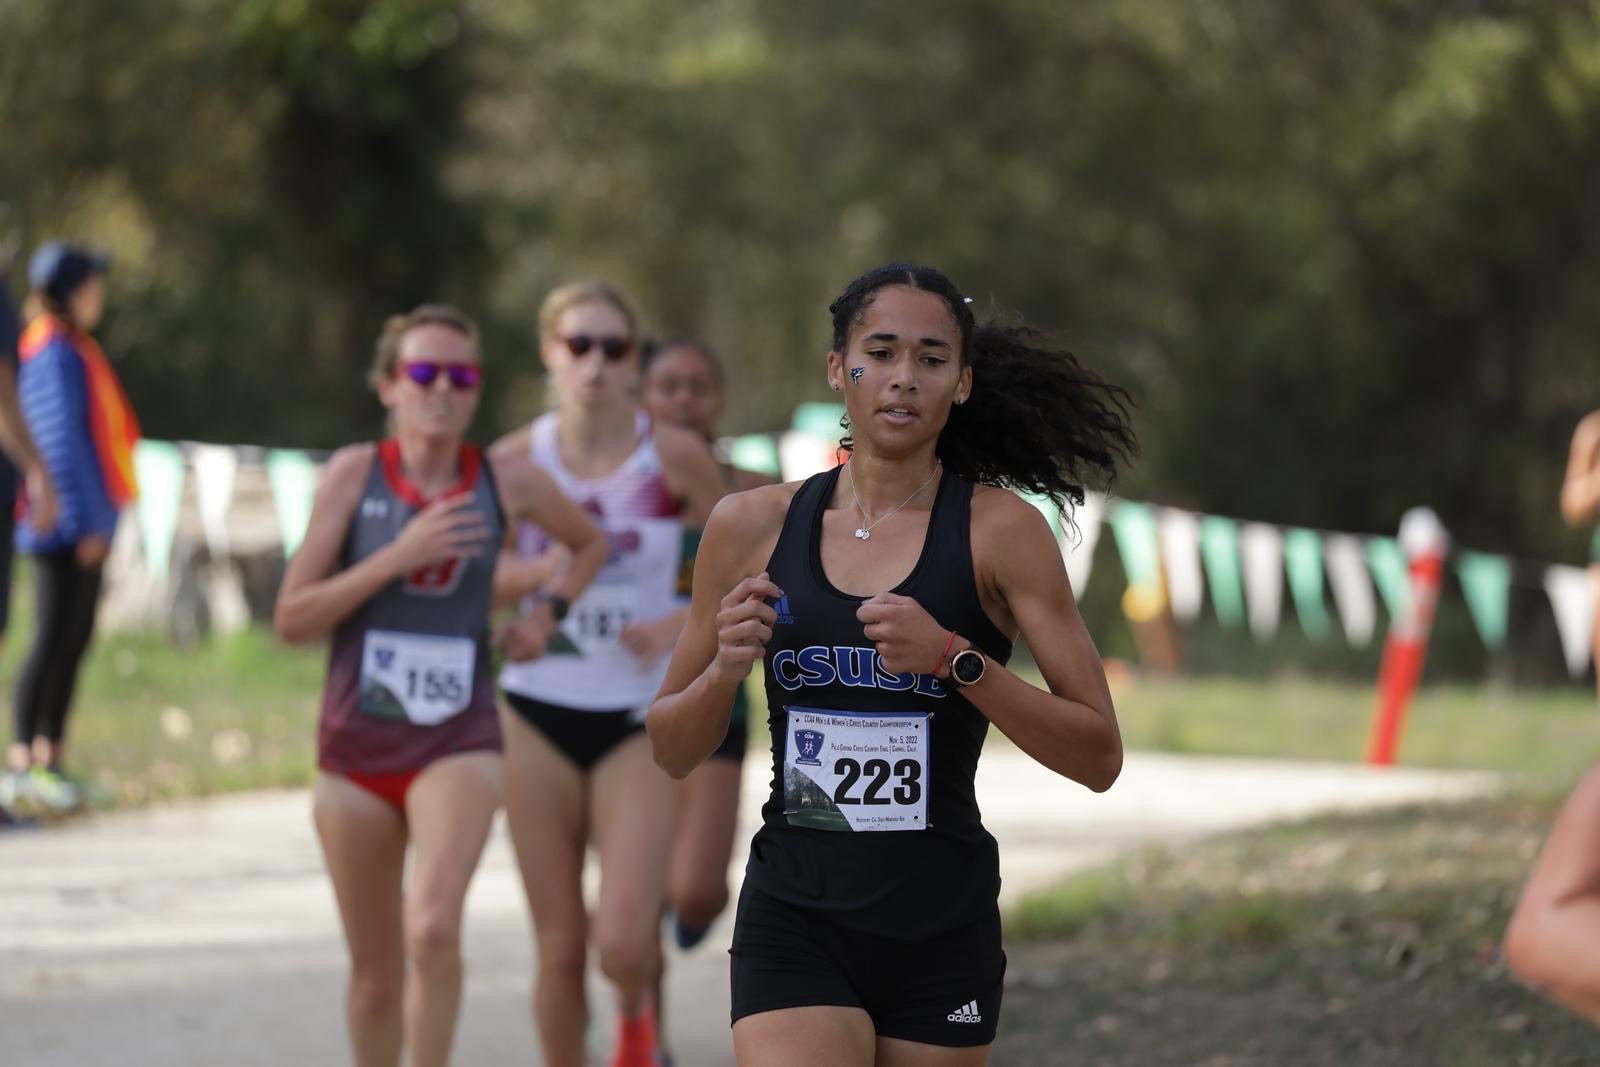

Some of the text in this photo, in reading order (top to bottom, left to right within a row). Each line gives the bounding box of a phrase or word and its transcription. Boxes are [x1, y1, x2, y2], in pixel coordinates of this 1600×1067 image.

[407, 669, 463, 700] 155
[905, 735, 918, 744] 2022
[834, 757, 922, 806] 223
[947, 1013, 982, 1024] adidas
